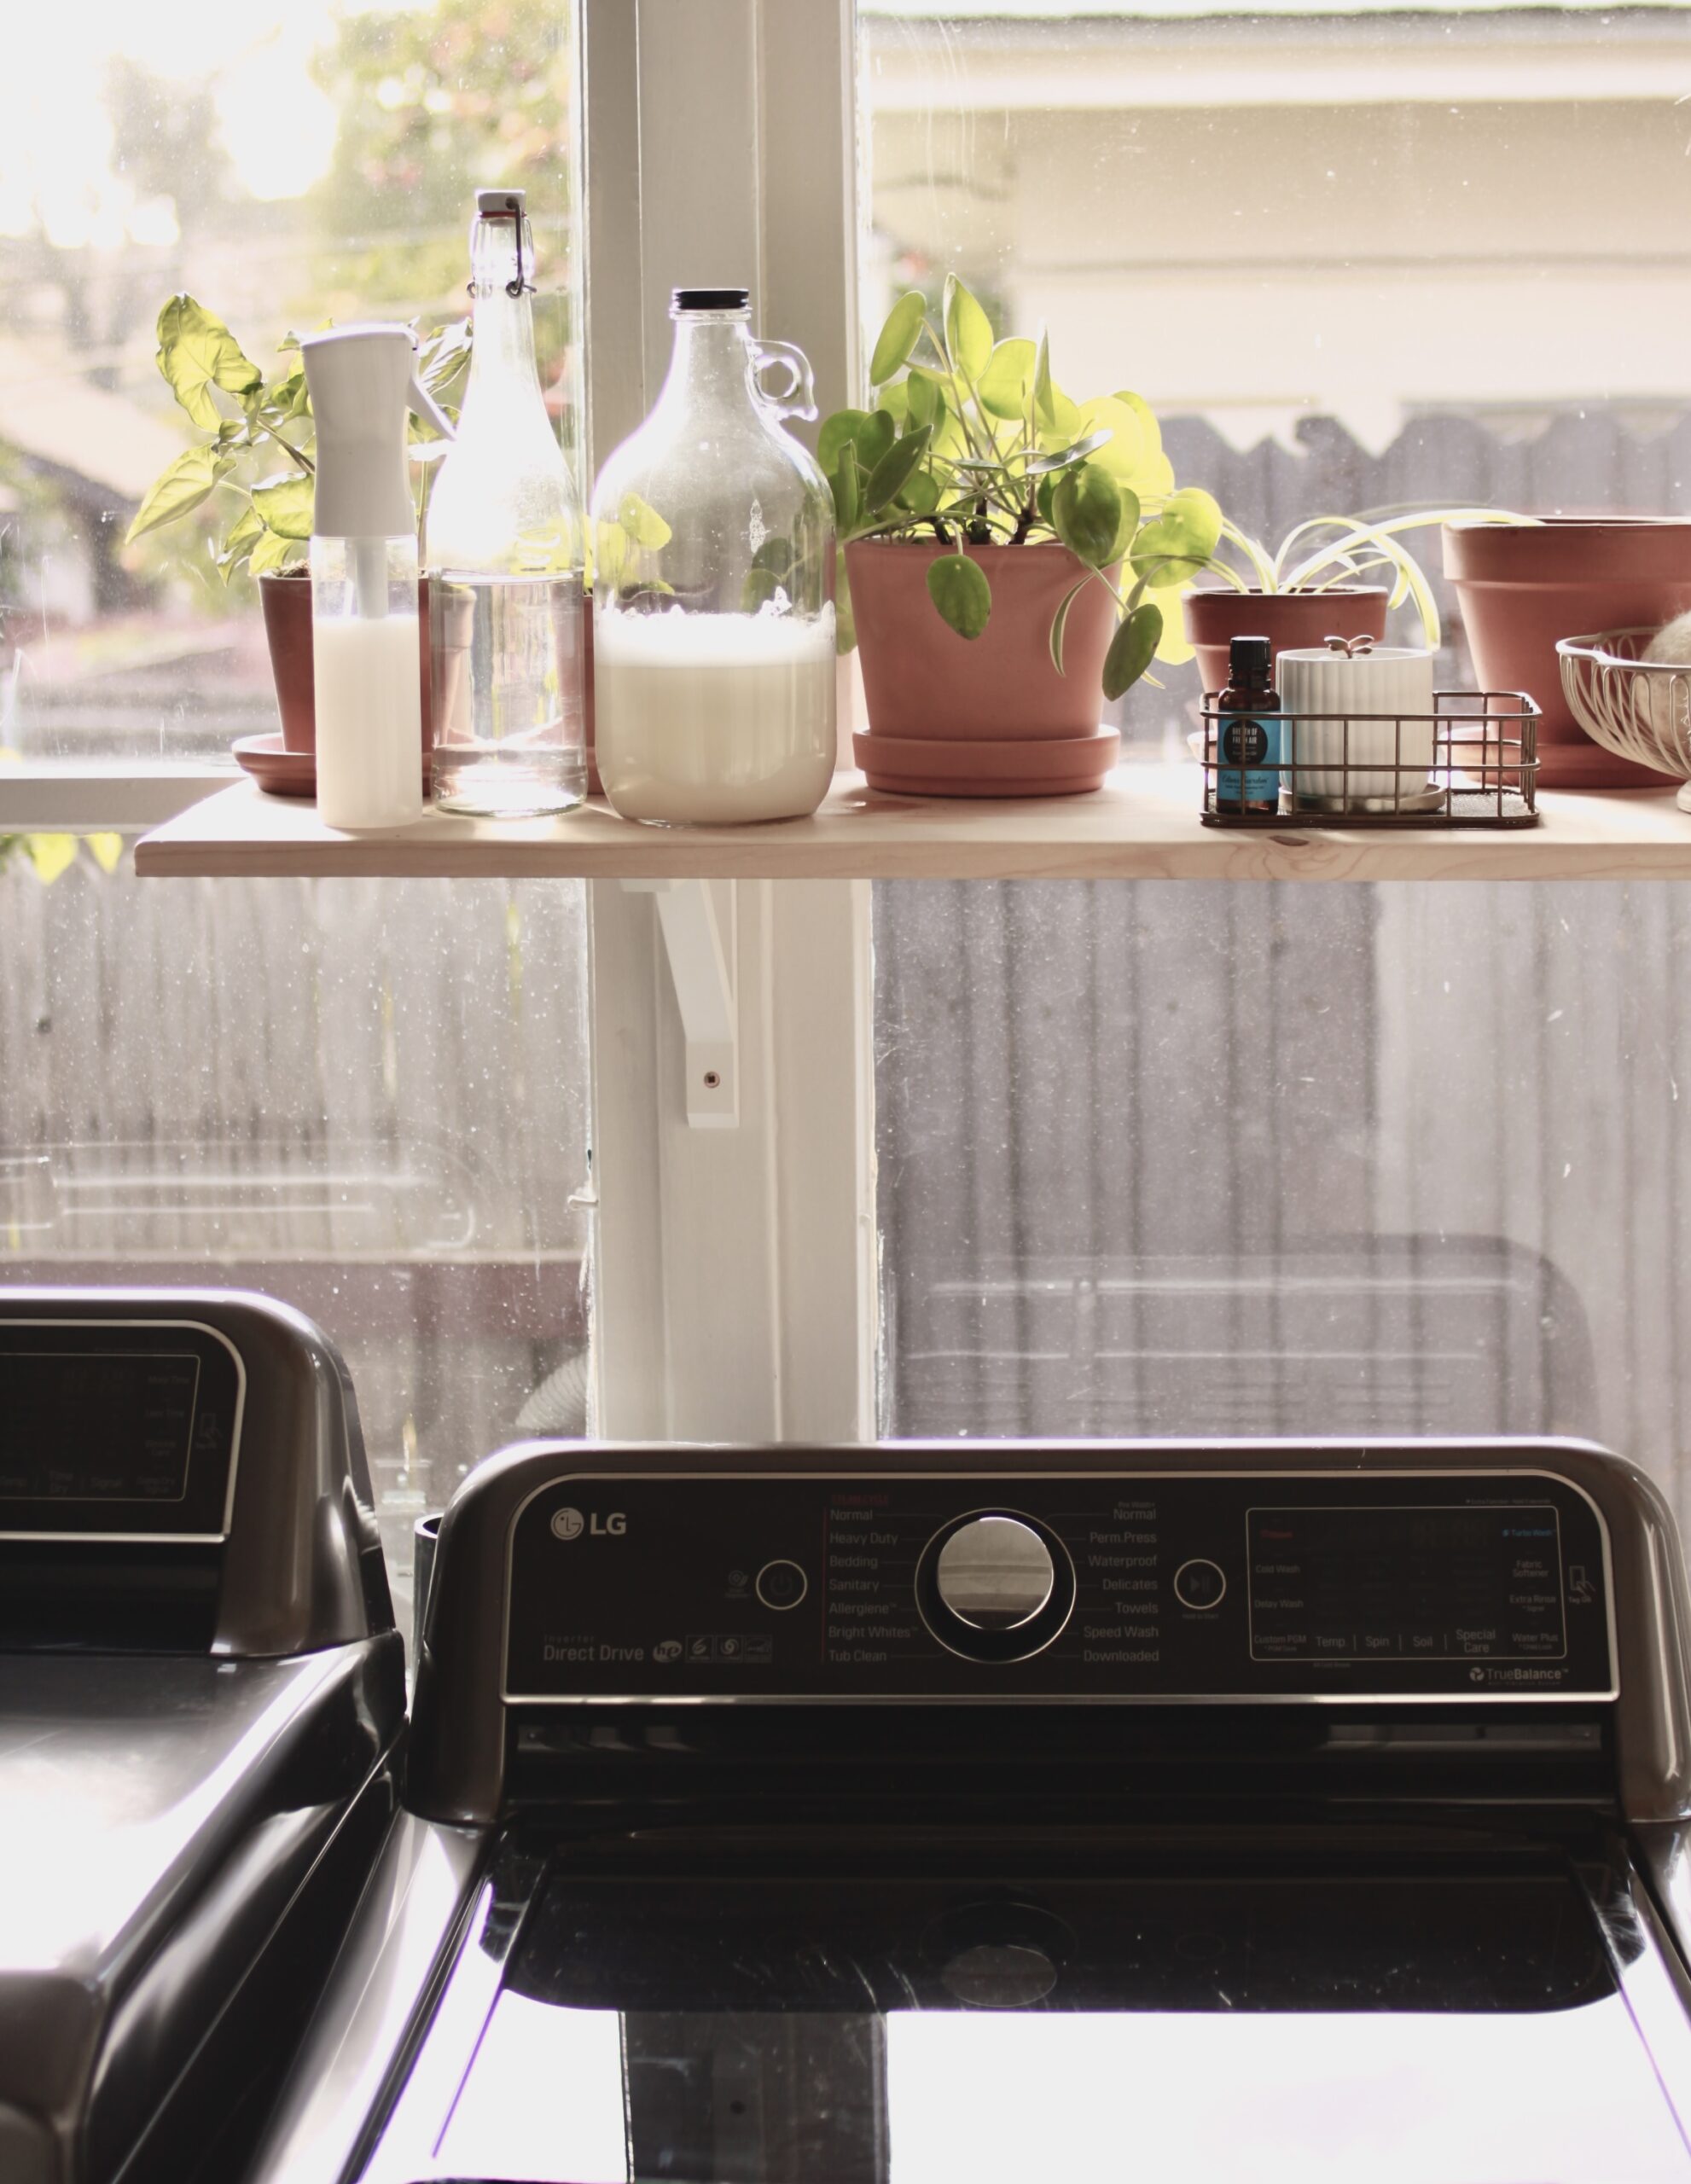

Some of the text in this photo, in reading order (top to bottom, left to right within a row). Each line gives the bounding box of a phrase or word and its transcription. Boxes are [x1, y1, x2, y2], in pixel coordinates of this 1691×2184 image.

[829, 1509, 873, 1521] Normal
[1113, 1508, 1157, 1520] Normal
[590, 1513, 626, 1535] LG
[829, 1532, 898, 1546] Heavy Duty
[1124, 1531, 1157, 1543] Press
[829, 1555, 879, 1570] Bedding
[1088, 1555, 1158, 1569] Waterproof
[828, 1579, 880, 1593] Sanitary
[1102, 1578, 1159, 1590] Delicates
[1114, 1601, 1159, 1614] Towels
[828, 1626, 865, 1640] Bright
[1083, 1625, 1159, 1640] Speed Wash
[1456, 1629, 1496, 1642] Special
[1365, 1635, 1390, 1650] Spin
[1412, 1635, 1433, 1647] Soil
[1464, 1642, 1490, 1653] Care
[543, 1644, 644, 1662] Direct Drive
[828, 1650, 888, 1662] Tub Clean
[1083, 1649, 1159, 1662] Downloaded
